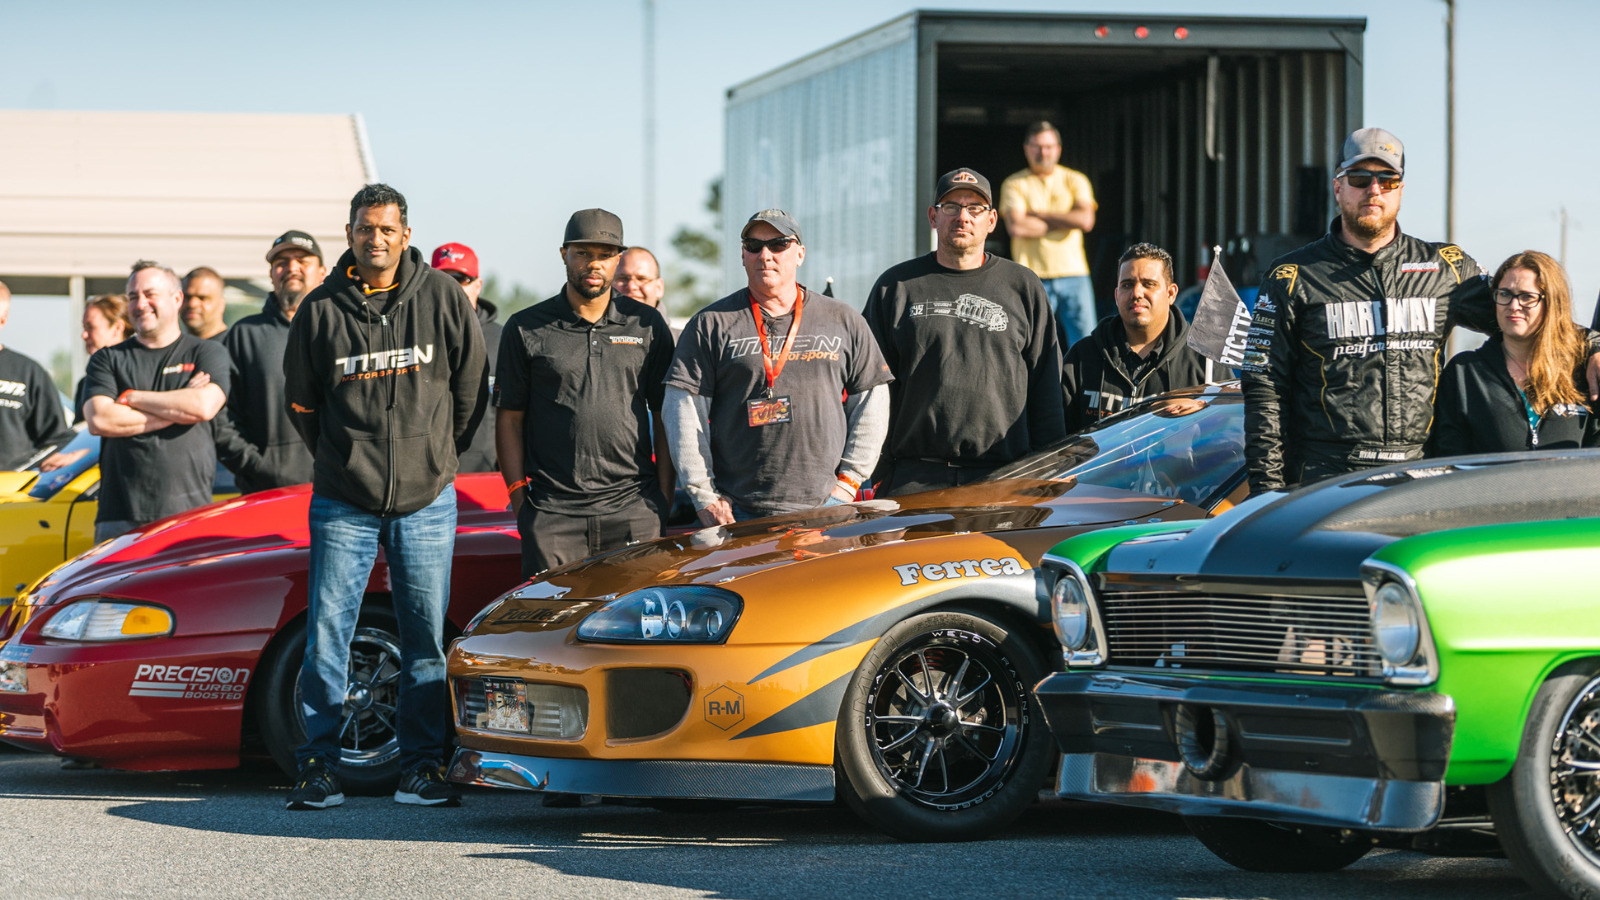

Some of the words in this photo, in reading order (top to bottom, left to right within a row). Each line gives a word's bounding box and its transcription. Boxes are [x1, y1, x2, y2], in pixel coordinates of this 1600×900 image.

[1325, 297, 1437, 339] HARDWAY
[335, 344, 434, 375] TITAN
[892, 557, 1025, 586] Ferrea
[932, 630, 981, 643] WELD
[134, 664, 250, 684] PRECISION
[184, 691, 242, 700] BOOSTED
[188, 683, 245, 692] TURBO
[708, 701, 740, 715] R-M
